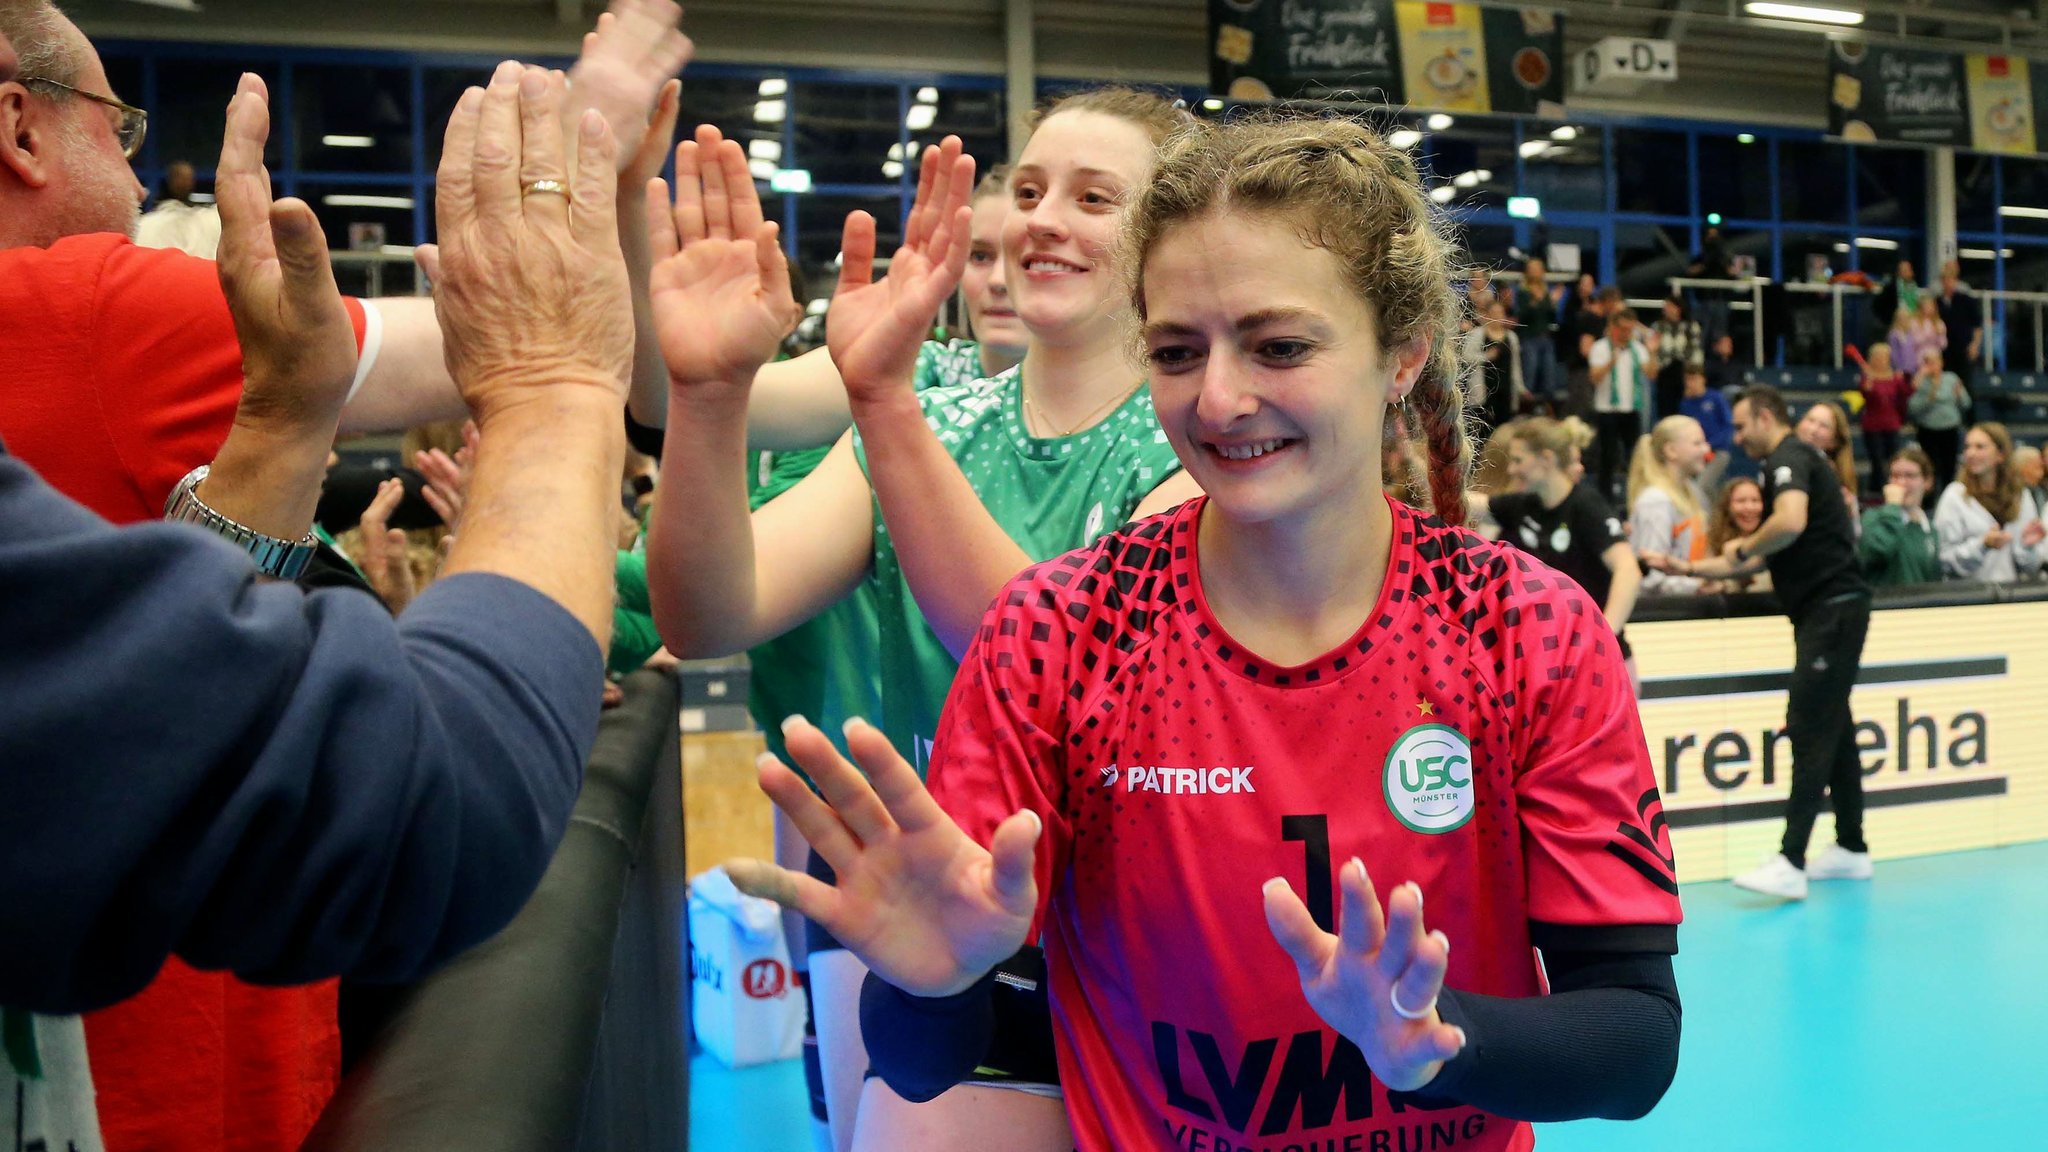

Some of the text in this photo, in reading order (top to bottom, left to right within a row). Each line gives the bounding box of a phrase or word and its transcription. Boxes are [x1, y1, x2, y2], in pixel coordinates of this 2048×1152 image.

[1632, 44, 1655, 72] D
[1127, 766, 1256, 794] PATRICK
[1399, 755, 1470, 792] USC
[1412, 792, 1459, 804] MÜNSTER
